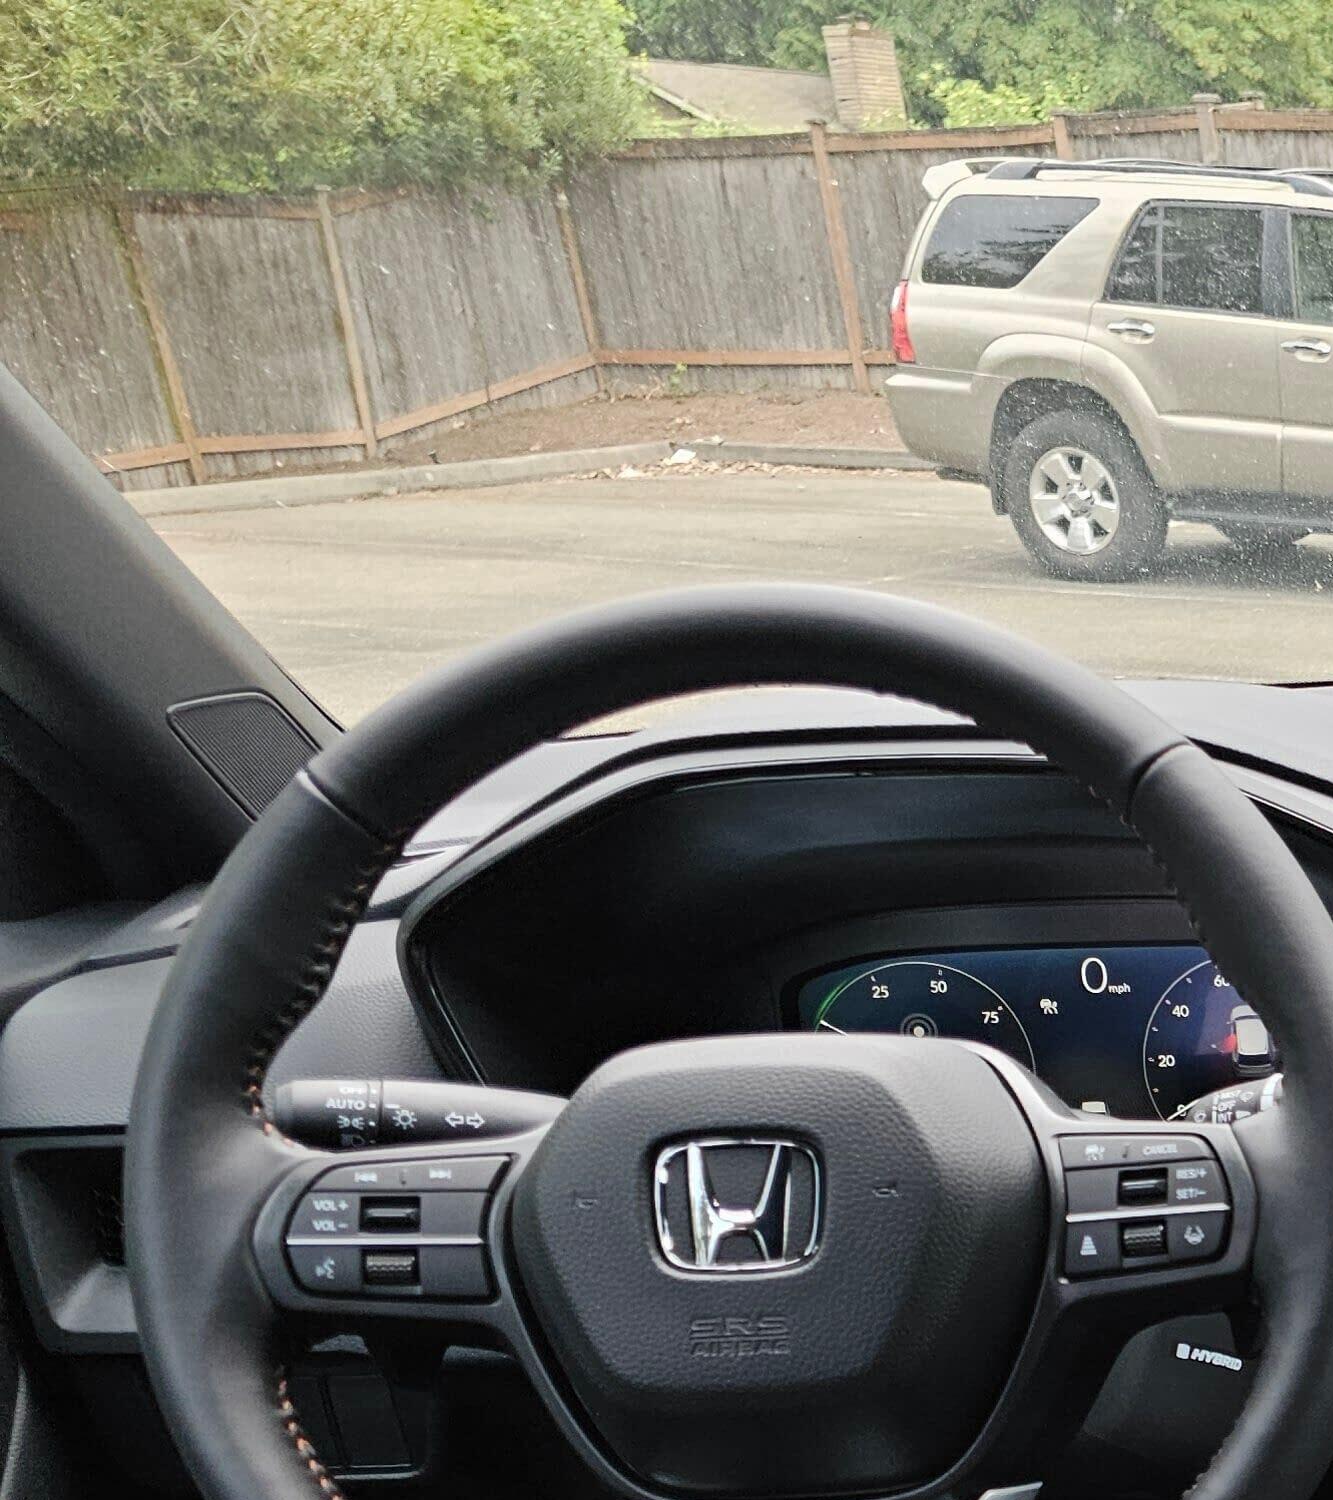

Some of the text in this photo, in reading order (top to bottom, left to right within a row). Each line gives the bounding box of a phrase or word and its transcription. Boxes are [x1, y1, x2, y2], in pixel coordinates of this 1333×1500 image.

[1081, 956, 1131, 994] 0 mph
[871, 985, 890, 999] 25
[930, 980, 948, 994] 50
[981, 1011, 1000, 1024] 75
[1172, 1005, 1190, 1018] 40
[1157, 1055, 1175, 1067] 20
[326, 1098, 366, 1110] AUTO
